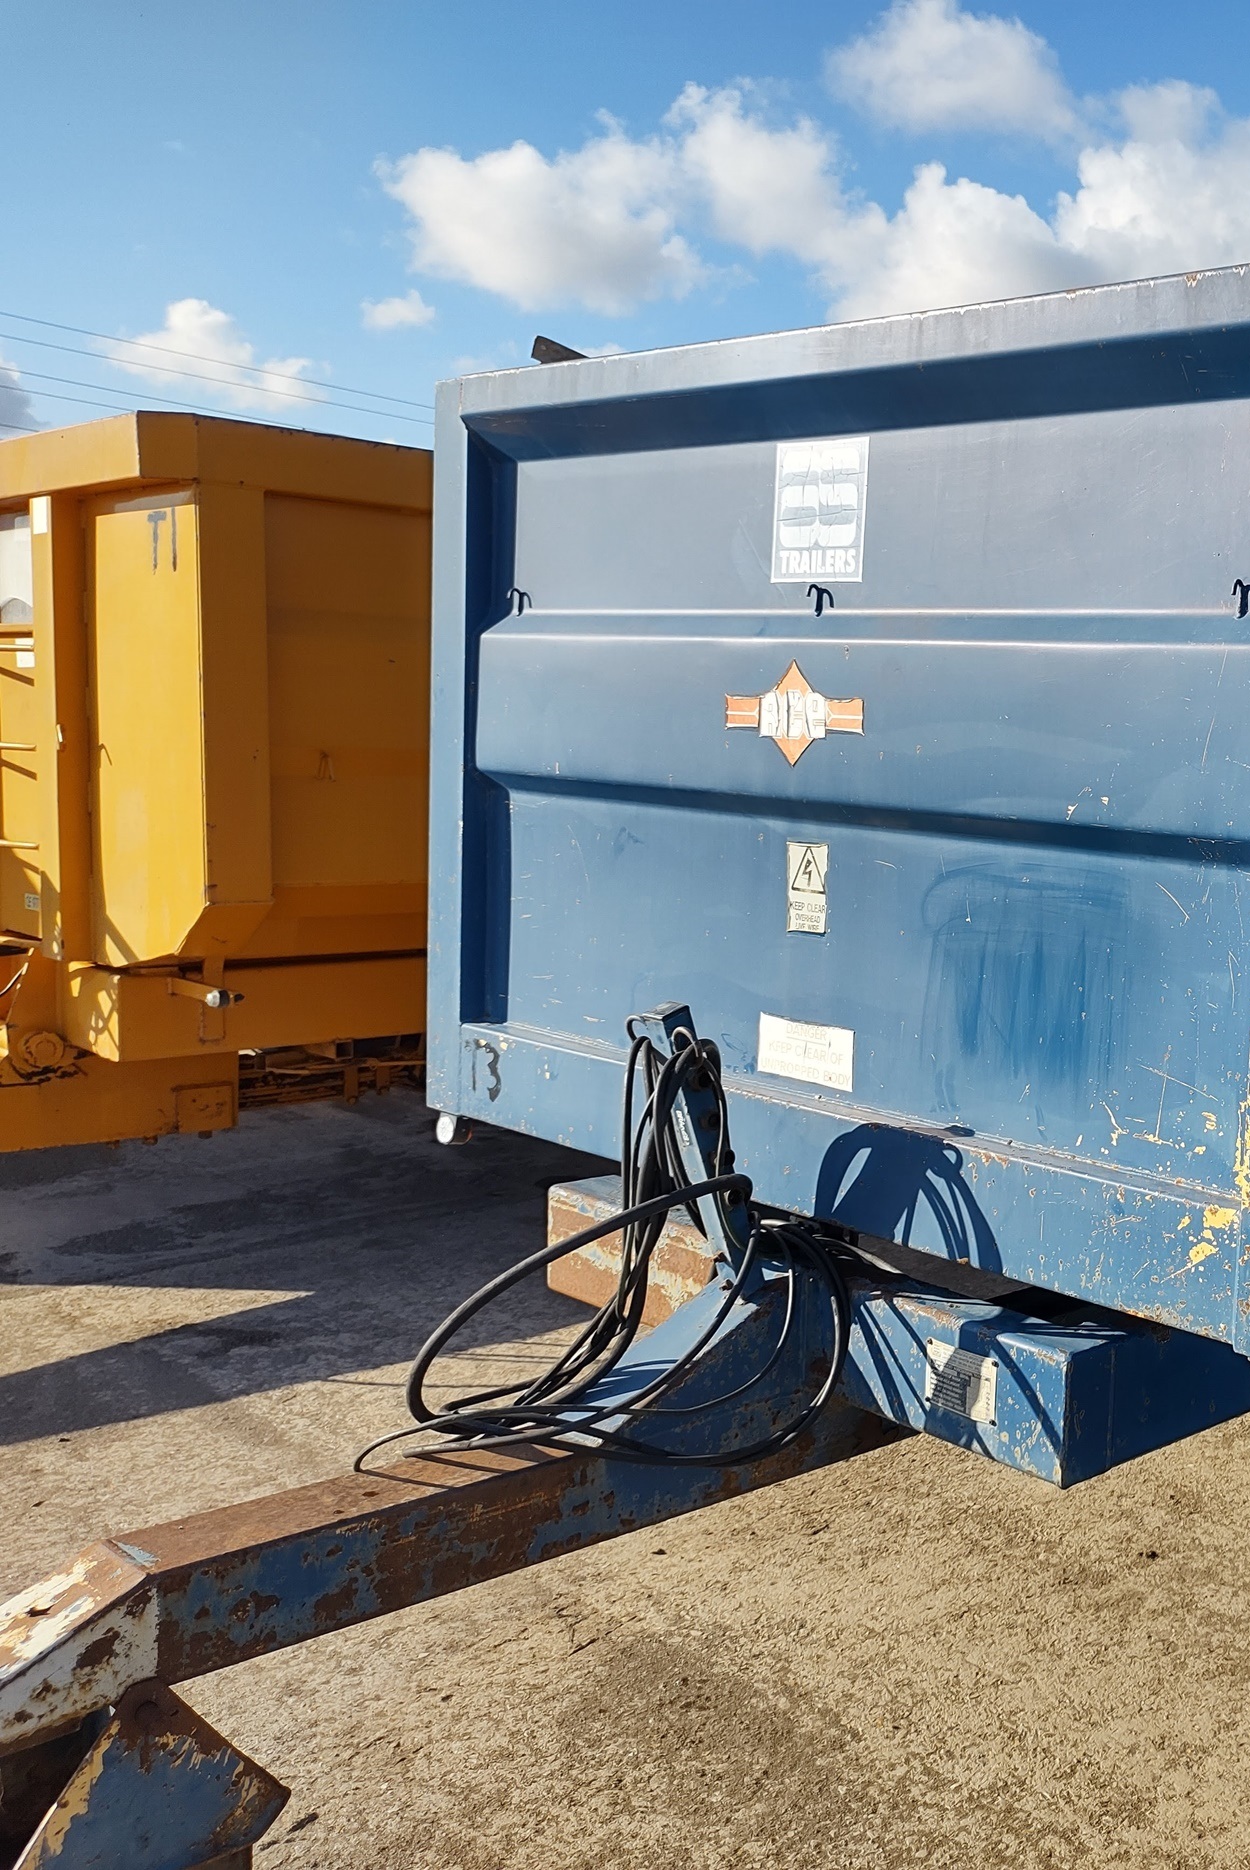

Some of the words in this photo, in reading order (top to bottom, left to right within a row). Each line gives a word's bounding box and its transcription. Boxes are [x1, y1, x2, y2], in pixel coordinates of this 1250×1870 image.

[779, 548, 857, 574] TRAILERS
[789, 900, 805, 912] KEEP
[806, 903, 826, 914] CLEAR
[795, 913, 821, 924] OVERHEAD
[785, 1022, 828, 1041] DANGER
[768, 1040, 793, 1054] KEEP
[794, 1045, 828, 1064] CLEAR
[829, 1051, 845, 1066] OF
[760, 1057, 820, 1080] UNPROPPED
[823, 1069, 852, 1087] BODY
